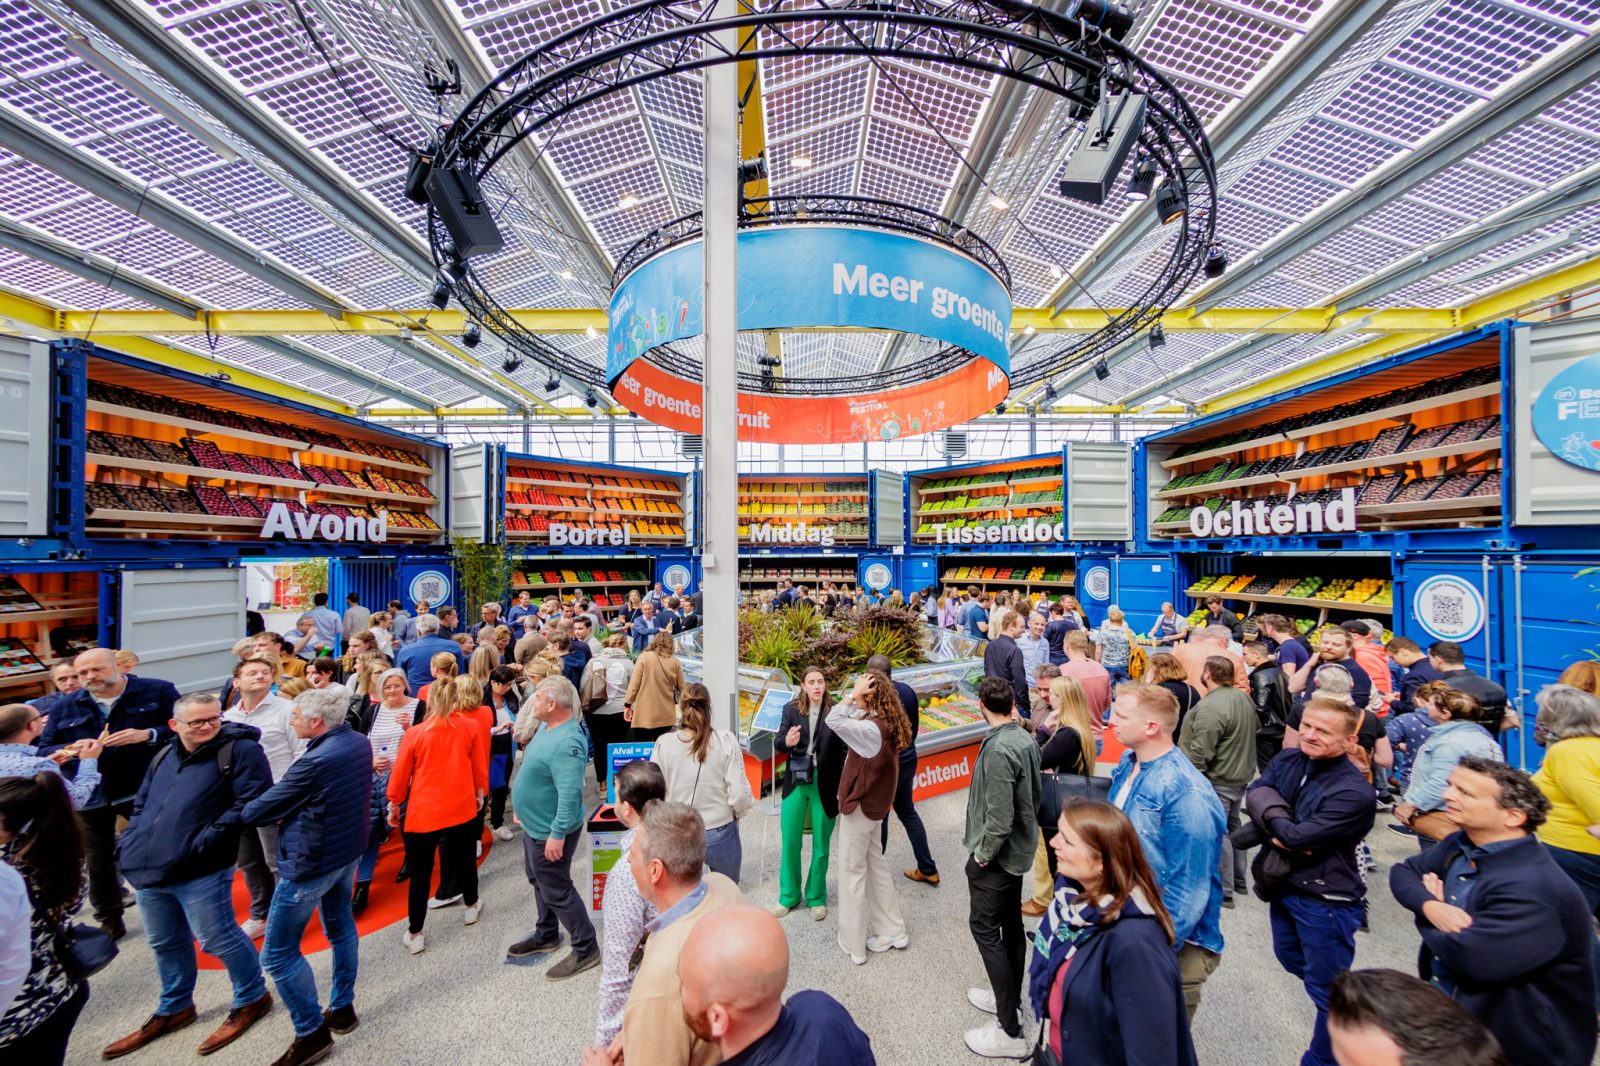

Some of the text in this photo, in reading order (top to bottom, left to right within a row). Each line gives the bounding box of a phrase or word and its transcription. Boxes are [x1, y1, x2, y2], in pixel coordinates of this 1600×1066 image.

[833, 263, 924, 304] Meer
[931, 287, 1003, 342] groente
[644, 386, 701, 419] groente
[737, 408, 771, 429] ruit
[260, 502, 387, 542] Avond
[1190, 487, 1357, 537] Ochtend
[550, 520, 631, 546] Borrel
[750, 522, 835, 546] Middag
[613, 747, 633, 755] Afval
